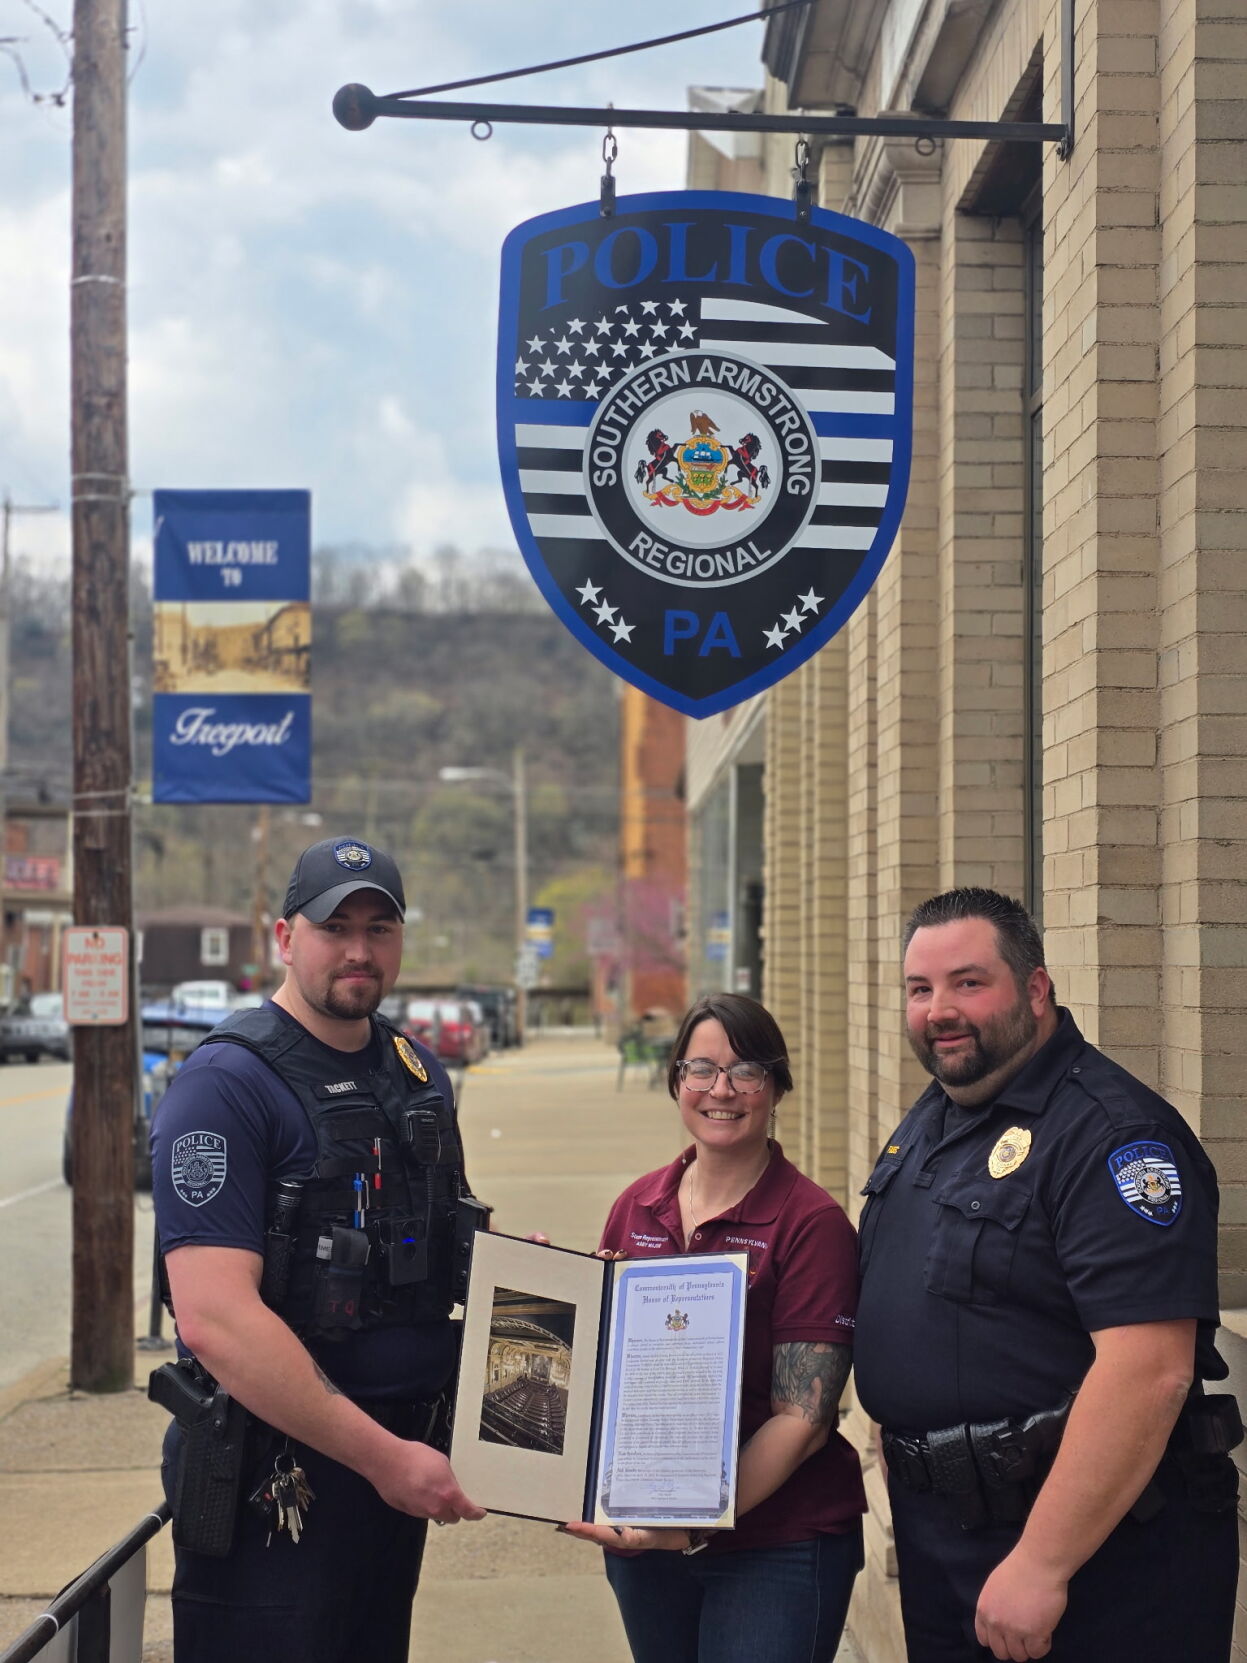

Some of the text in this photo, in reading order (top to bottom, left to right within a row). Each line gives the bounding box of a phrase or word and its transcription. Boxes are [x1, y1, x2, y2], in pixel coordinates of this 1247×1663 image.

[541, 222, 872, 324] POLICE
[593, 358, 811, 496] SOUTHERN ARMSTRONG
[187, 540, 278, 565] WELCOME
[628, 531, 772, 577] REGIONAL
[220, 567, 242, 587] TO
[663, 610, 742, 658] PA
[169, 707, 294, 756] Freeport
[324, 1081, 358, 1094] TACKETT
[176, 1135, 221, 1152] POLICE
[1115, 1146, 1169, 1169] POLICE
[191, 1190, 204, 1199] PA
